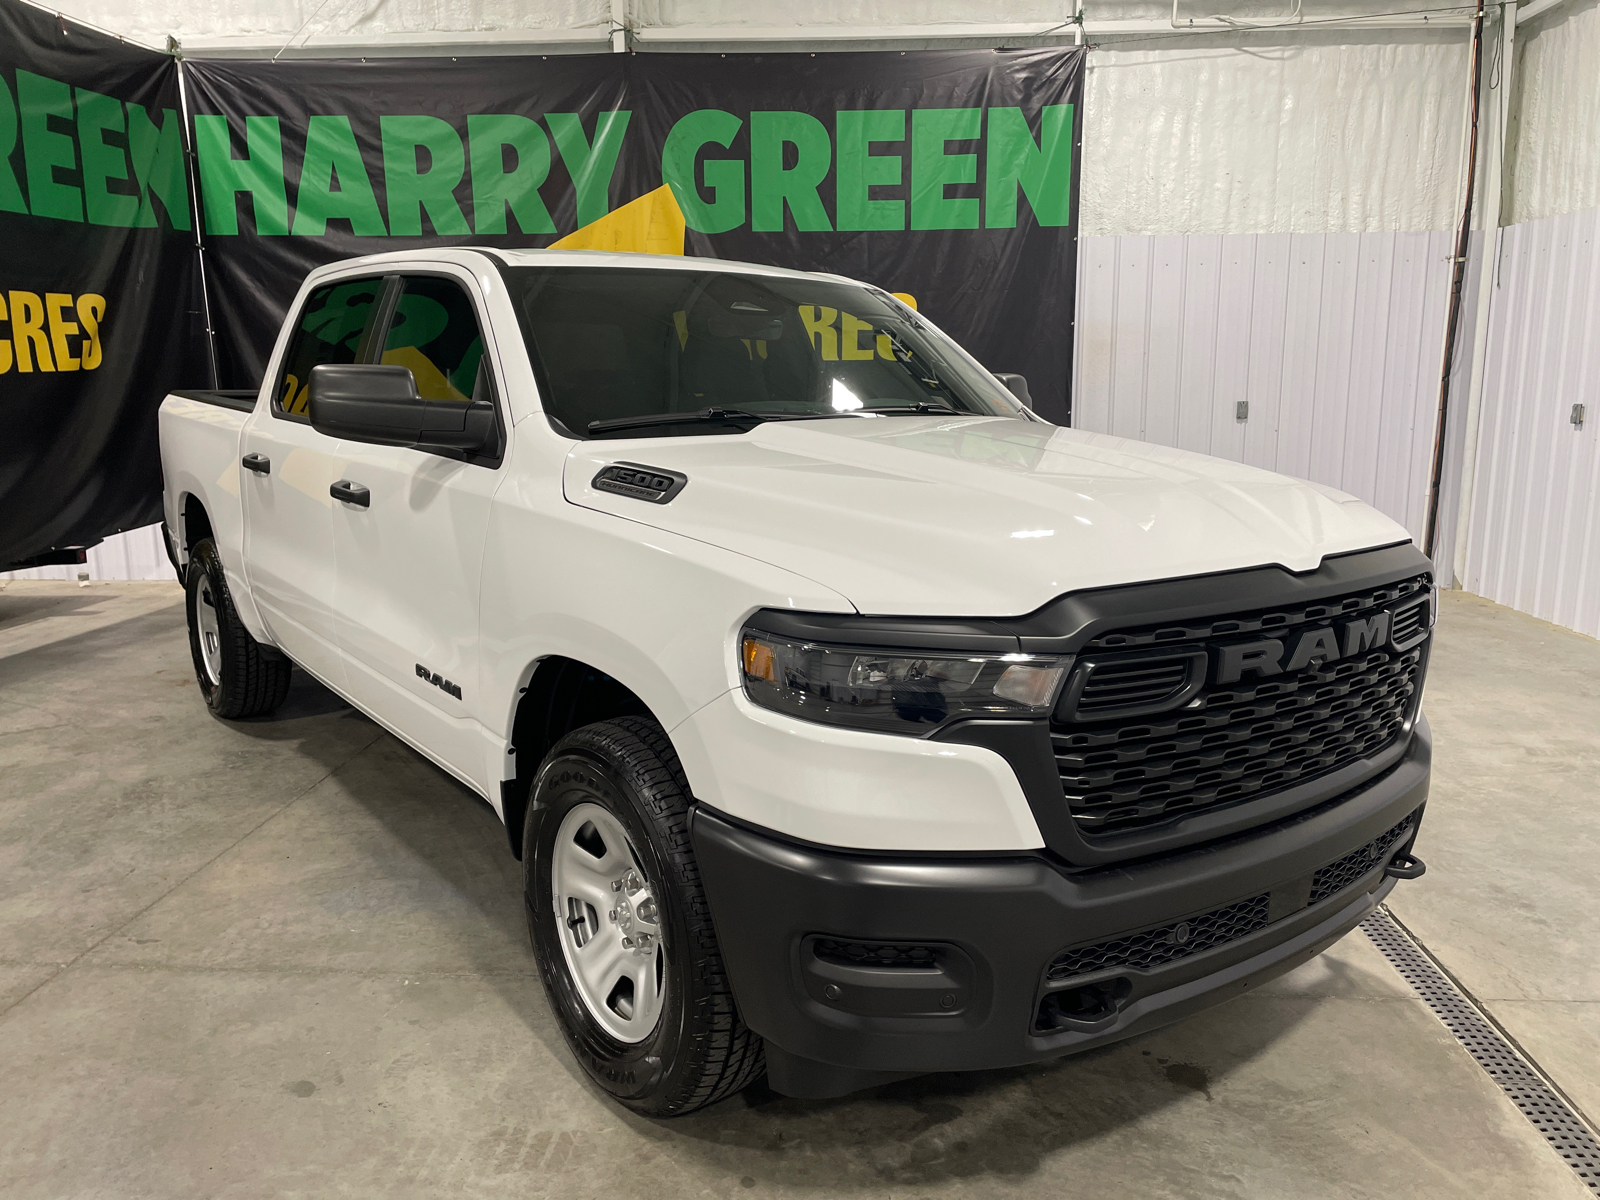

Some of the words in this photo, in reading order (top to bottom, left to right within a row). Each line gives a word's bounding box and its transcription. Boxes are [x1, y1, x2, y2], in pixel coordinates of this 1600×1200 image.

[194, 110, 632, 236] HARRY
[662, 104, 1074, 234] GREEN
[604, 468, 671, 491] 1500
[1216, 610, 1390, 685] RAM
[415, 662, 462, 701] RAM
